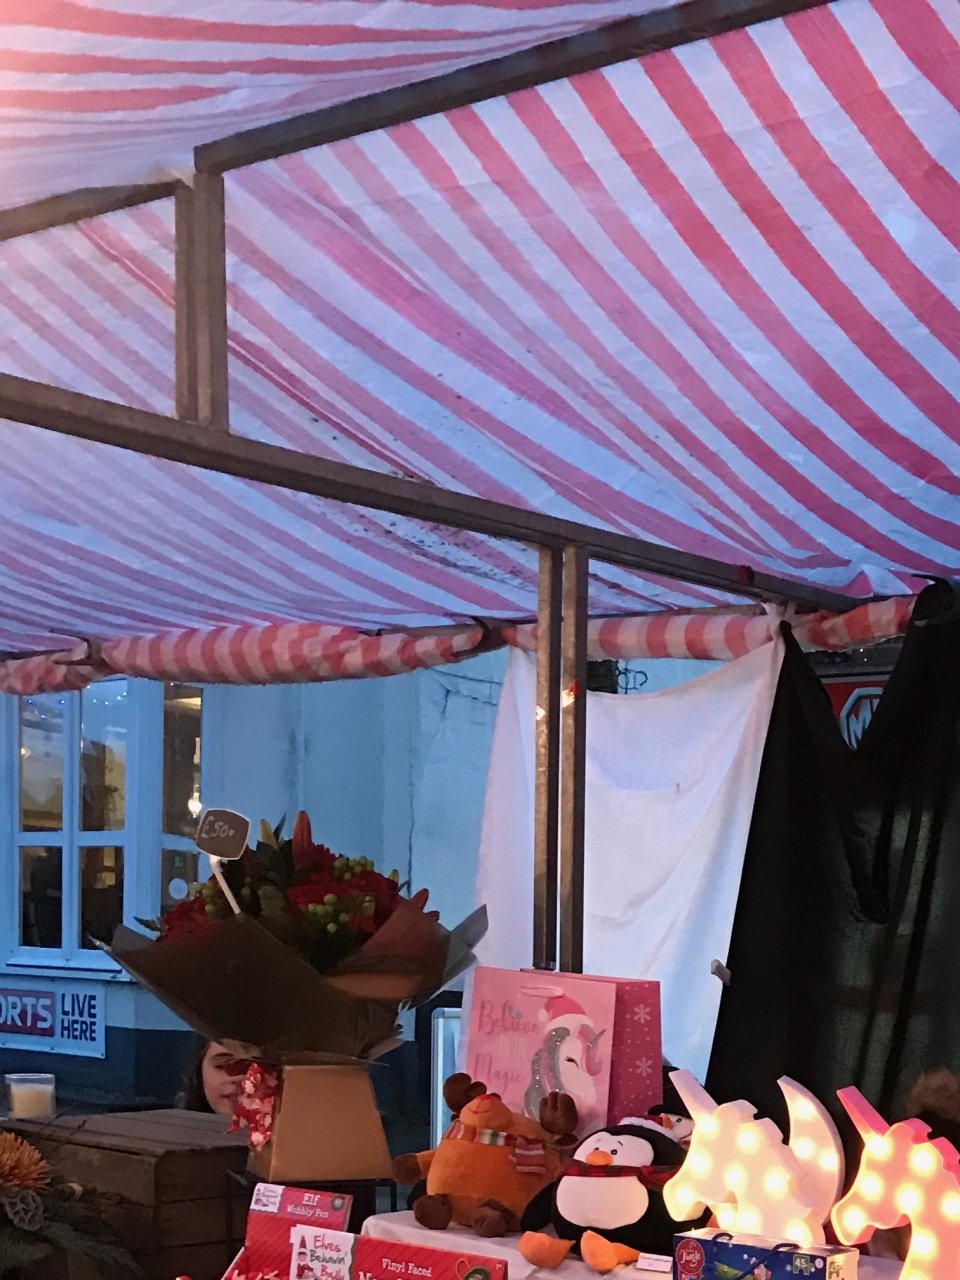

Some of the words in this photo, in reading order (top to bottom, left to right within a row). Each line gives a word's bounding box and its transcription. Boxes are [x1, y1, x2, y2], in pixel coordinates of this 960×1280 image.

[61, 993, 97, 1018] LIVE
[60, 1019, 97, 1041] HERE
[313, 1233, 341, 1253] Elves
[382, 1258, 406, 1273] Vinyl
[408, 1263, 432, 1277] Faced
